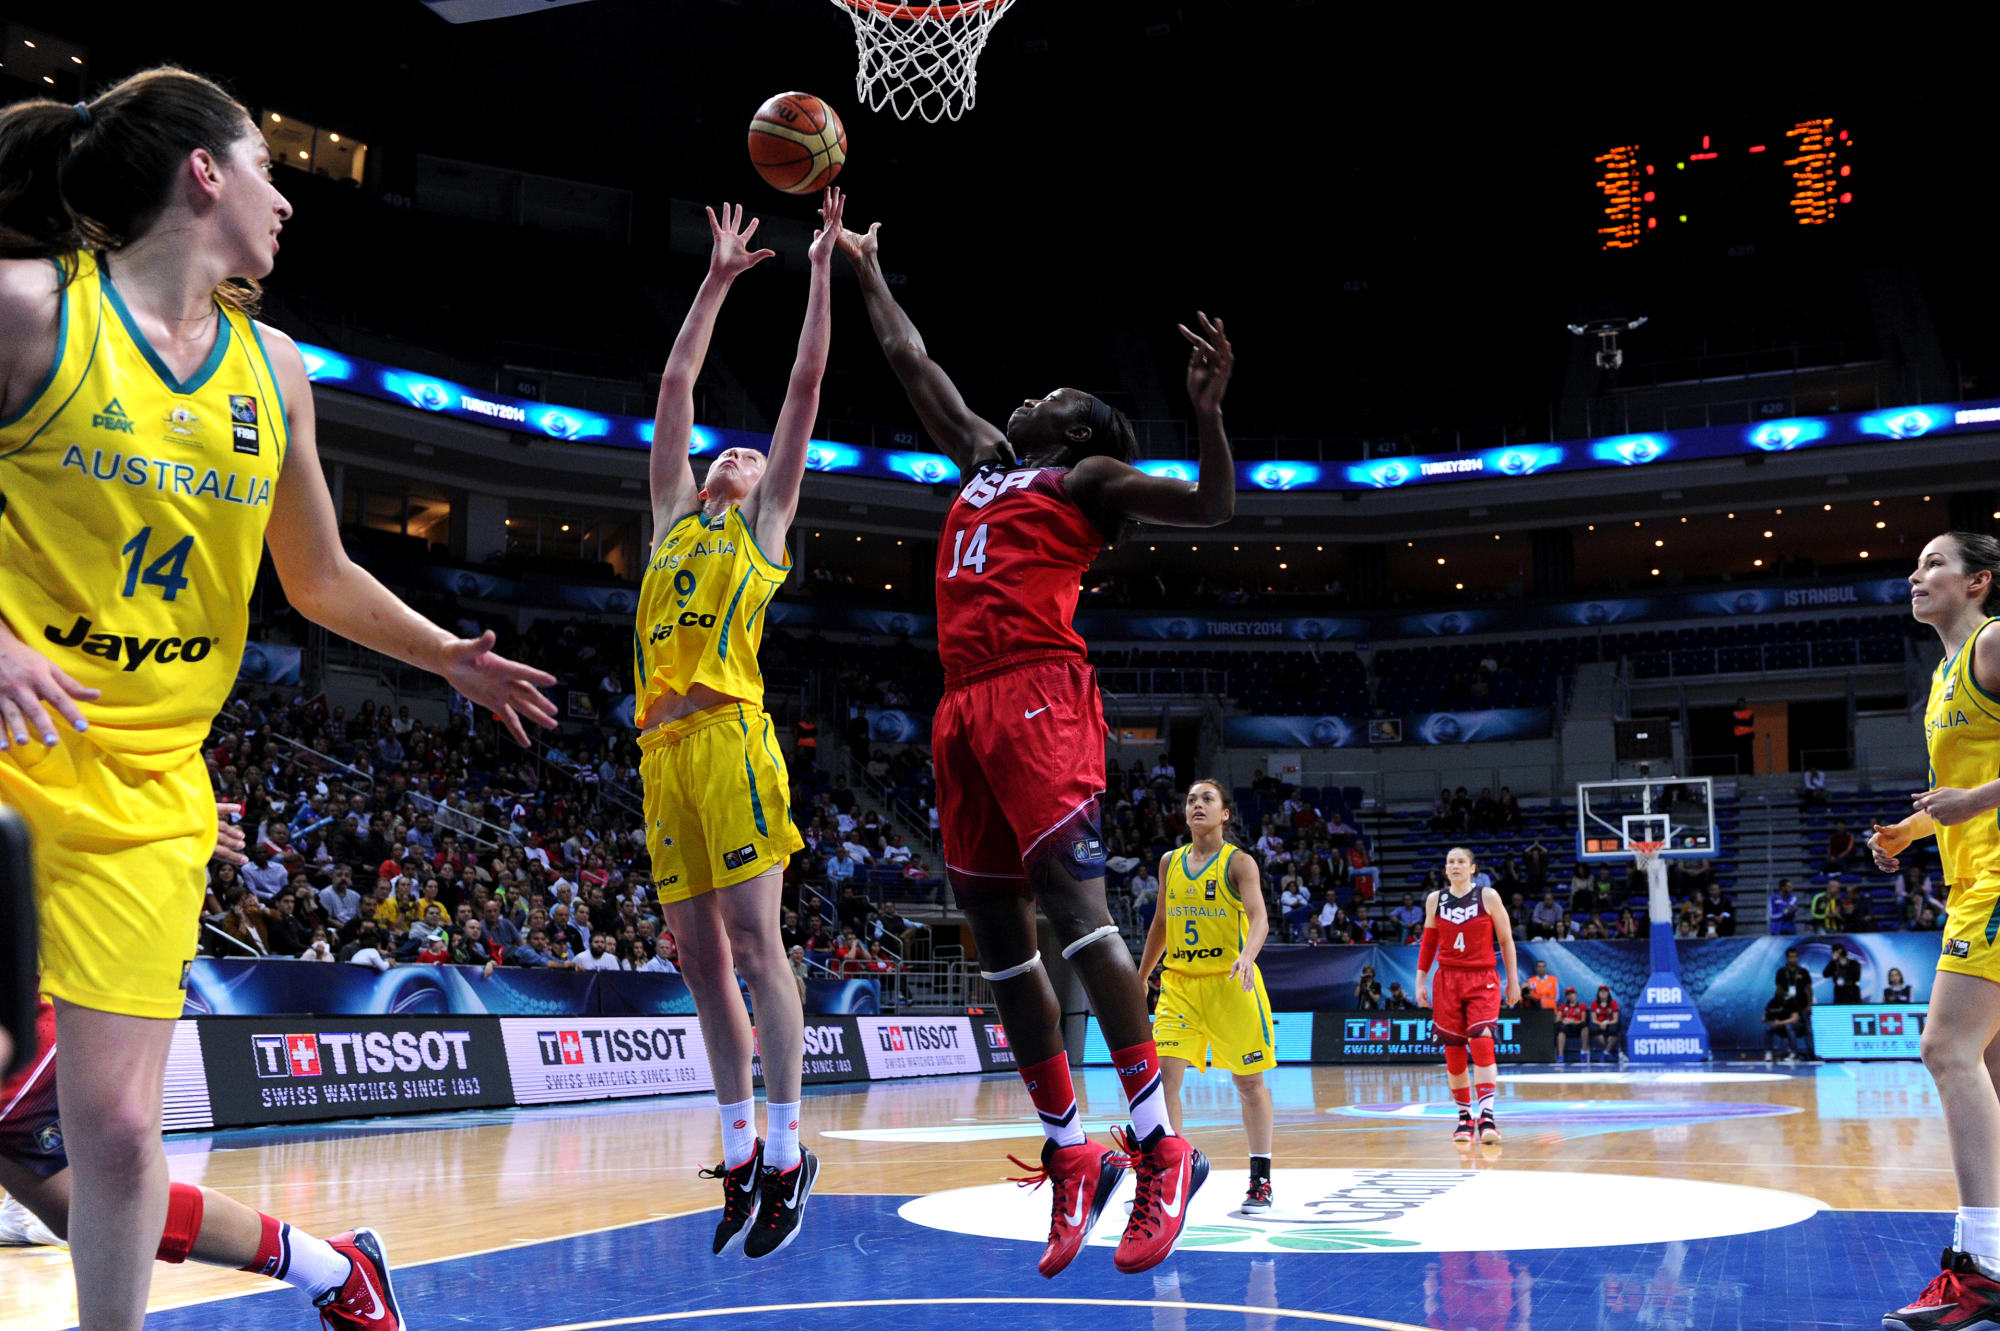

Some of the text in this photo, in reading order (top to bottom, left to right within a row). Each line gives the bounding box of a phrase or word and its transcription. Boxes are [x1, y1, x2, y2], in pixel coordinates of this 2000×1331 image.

[92, 413, 135, 435] PEAK
[61, 444, 271, 507] AUSTRALIA
[961, 470, 1041, 509] USA
[121, 526, 194, 602] 14
[947, 523, 988, 578] 14
[674, 569, 697, 609] 9
[1784, 585, 1858, 607] ISTANBUL
[44, 616, 213, 672] Jayco
[1440, 903, 1478, 925] USA
[1184, 919, 1199, 946] 5
[1453, 931, 1466, 953] 4
[1173, 946, 1223, 962] Jayco
[1646, 987, 1682, 1004] FIBA
[803, 1025, 844, 1055] SOT
[902, 1025, 958, 1050] TISSOT
[1392, 1018, 1521, 1041] TIT
[319, 1030, 471, 1075] TISSOT
[582, 1028, 686, 1063] TISSOT
[1634, 1037, 1704, 1055] ISTANBUL
[261, 1077, 481, 1107] SWISS WATCHES SINCE 1853
[545, 1067, 696, 1090] SWISS WATCHES SINCE 1853
